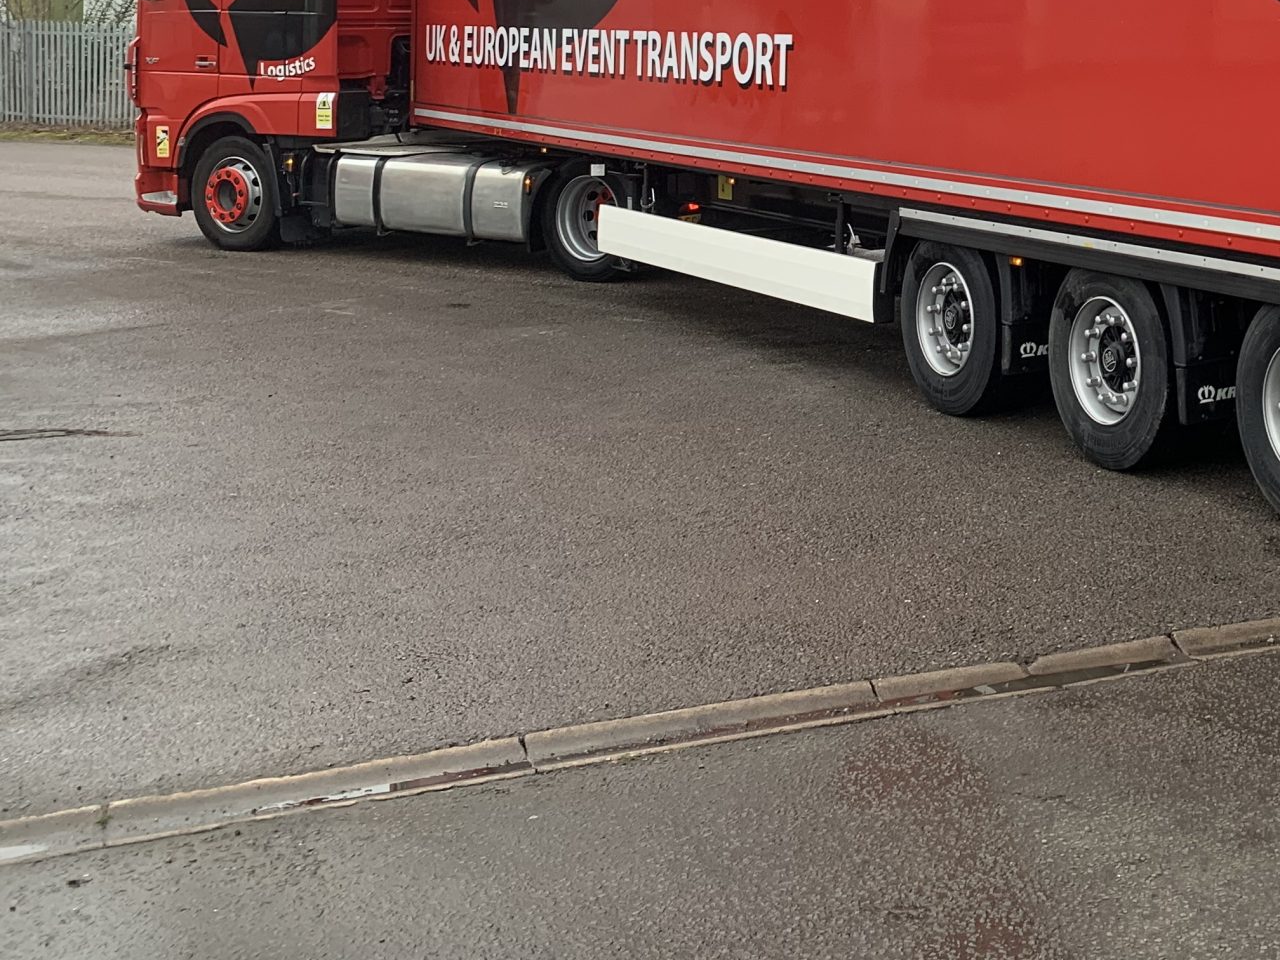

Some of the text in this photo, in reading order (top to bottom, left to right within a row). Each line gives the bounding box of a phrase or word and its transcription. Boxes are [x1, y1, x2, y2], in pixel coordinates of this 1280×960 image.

[260, 56, 316, 81] Logistics
[425, 24, 793, 88] UK & EUROPEAN EVENT TRANSPORT
